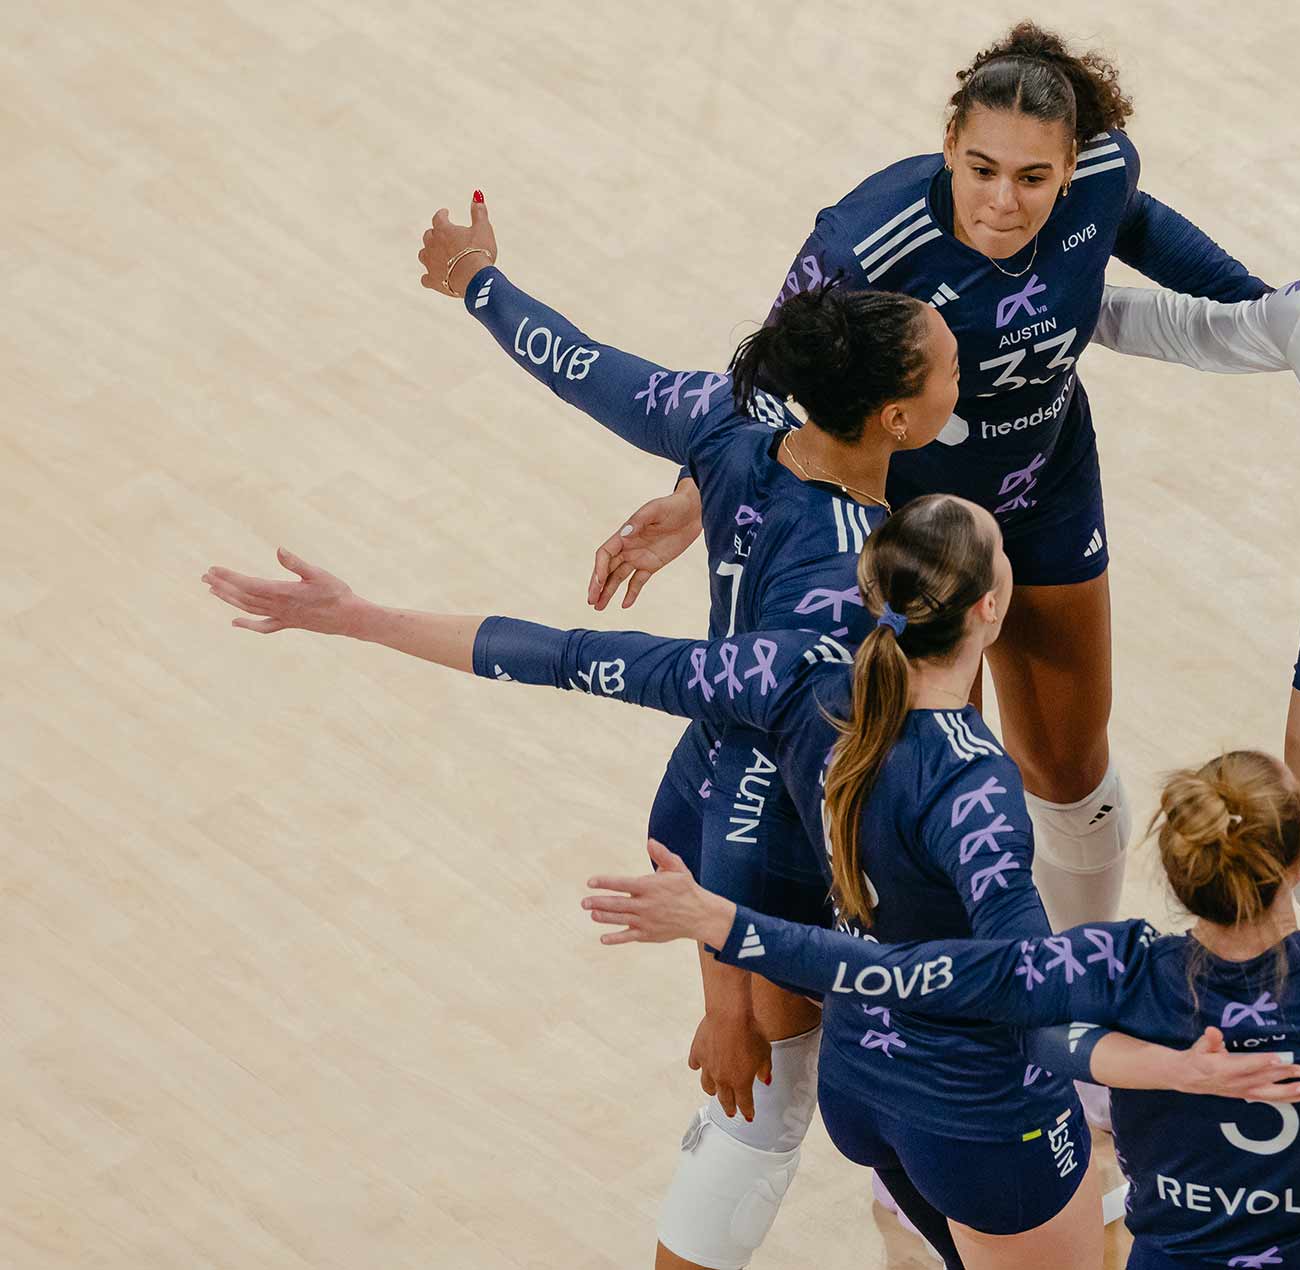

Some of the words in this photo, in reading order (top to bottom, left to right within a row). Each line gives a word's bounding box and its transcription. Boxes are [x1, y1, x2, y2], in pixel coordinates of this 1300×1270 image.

[1062, 223, 1097, 252] LOVB
[514, 316, 600, 380] LOVB
[999, 317, 1057, 349] AUSTIN
[976, 327, 1077, 397] 33
[716, 561, 744, 638] 7
[832, 956, 953, 999] LOVB
